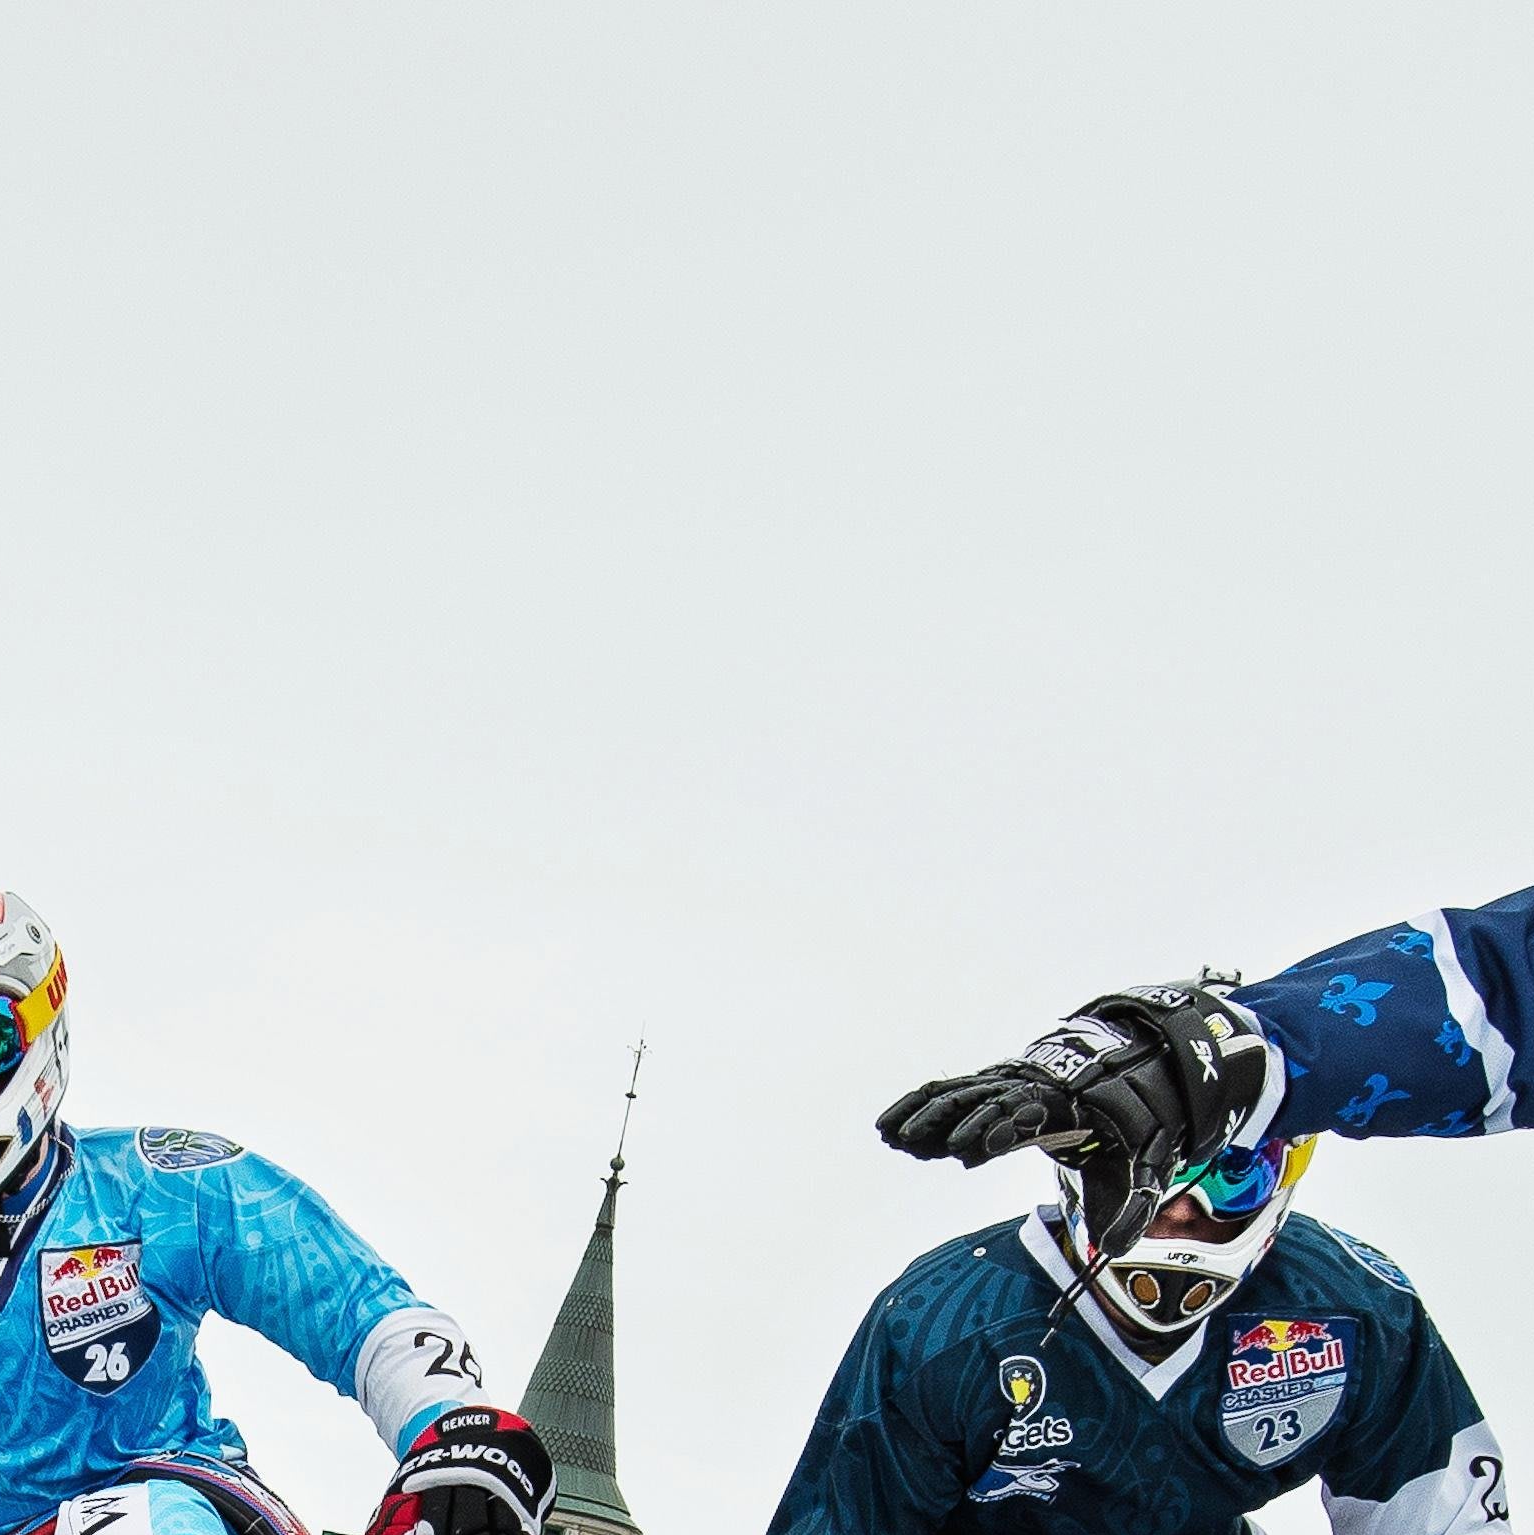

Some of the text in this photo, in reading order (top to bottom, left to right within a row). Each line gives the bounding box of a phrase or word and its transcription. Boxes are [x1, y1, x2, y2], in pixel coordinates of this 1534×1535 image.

[47, 1263, 141, 1318] Red Bull
[48, 1302, 129, 1338] CRASHED
[83, 1342, 131, 1382] 26
[1227, 1338, 1346, 1390] Red Bull
[1222, 1378, 1315, 1410] CRASHED
[442, 1413, 491, 1432] REKKER
[1003, 1415, 1074, 1451] Gets
[1252, 1407, 1304, 1455] 23
[402, 1443, 535, 1498] ER-WOOD
[1469, 1455, 1509, 1524] 2
